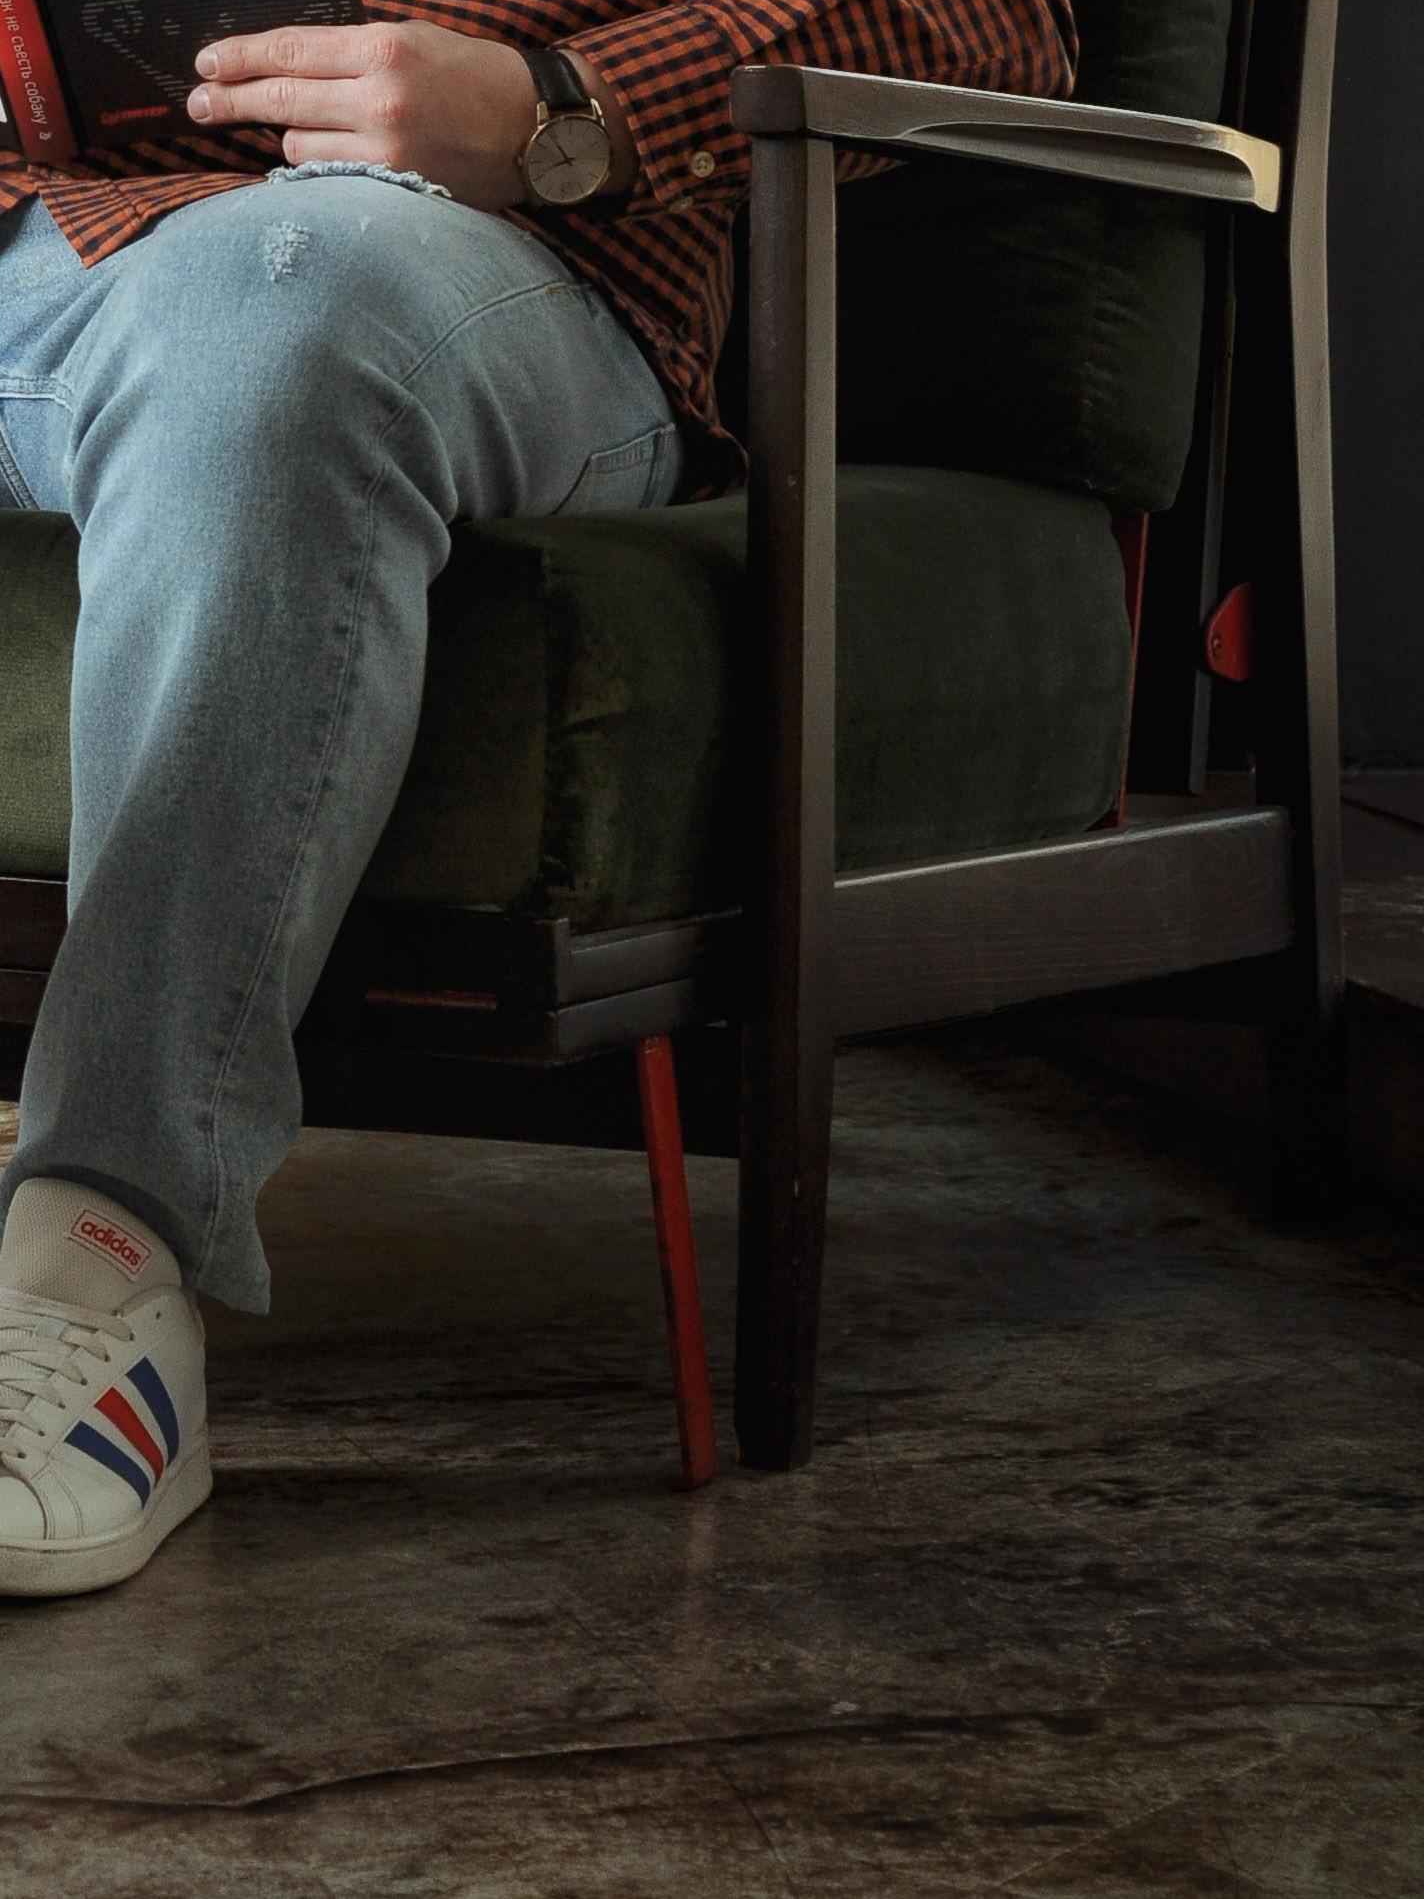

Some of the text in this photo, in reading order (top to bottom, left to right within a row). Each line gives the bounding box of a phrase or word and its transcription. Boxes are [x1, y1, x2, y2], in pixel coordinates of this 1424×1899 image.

[4, 16, 20, 32] не
[11, 35, 32, 79] съесть
[24, 81, 49, 125] собаку
[80, 1221, 141, 1266] adidas
